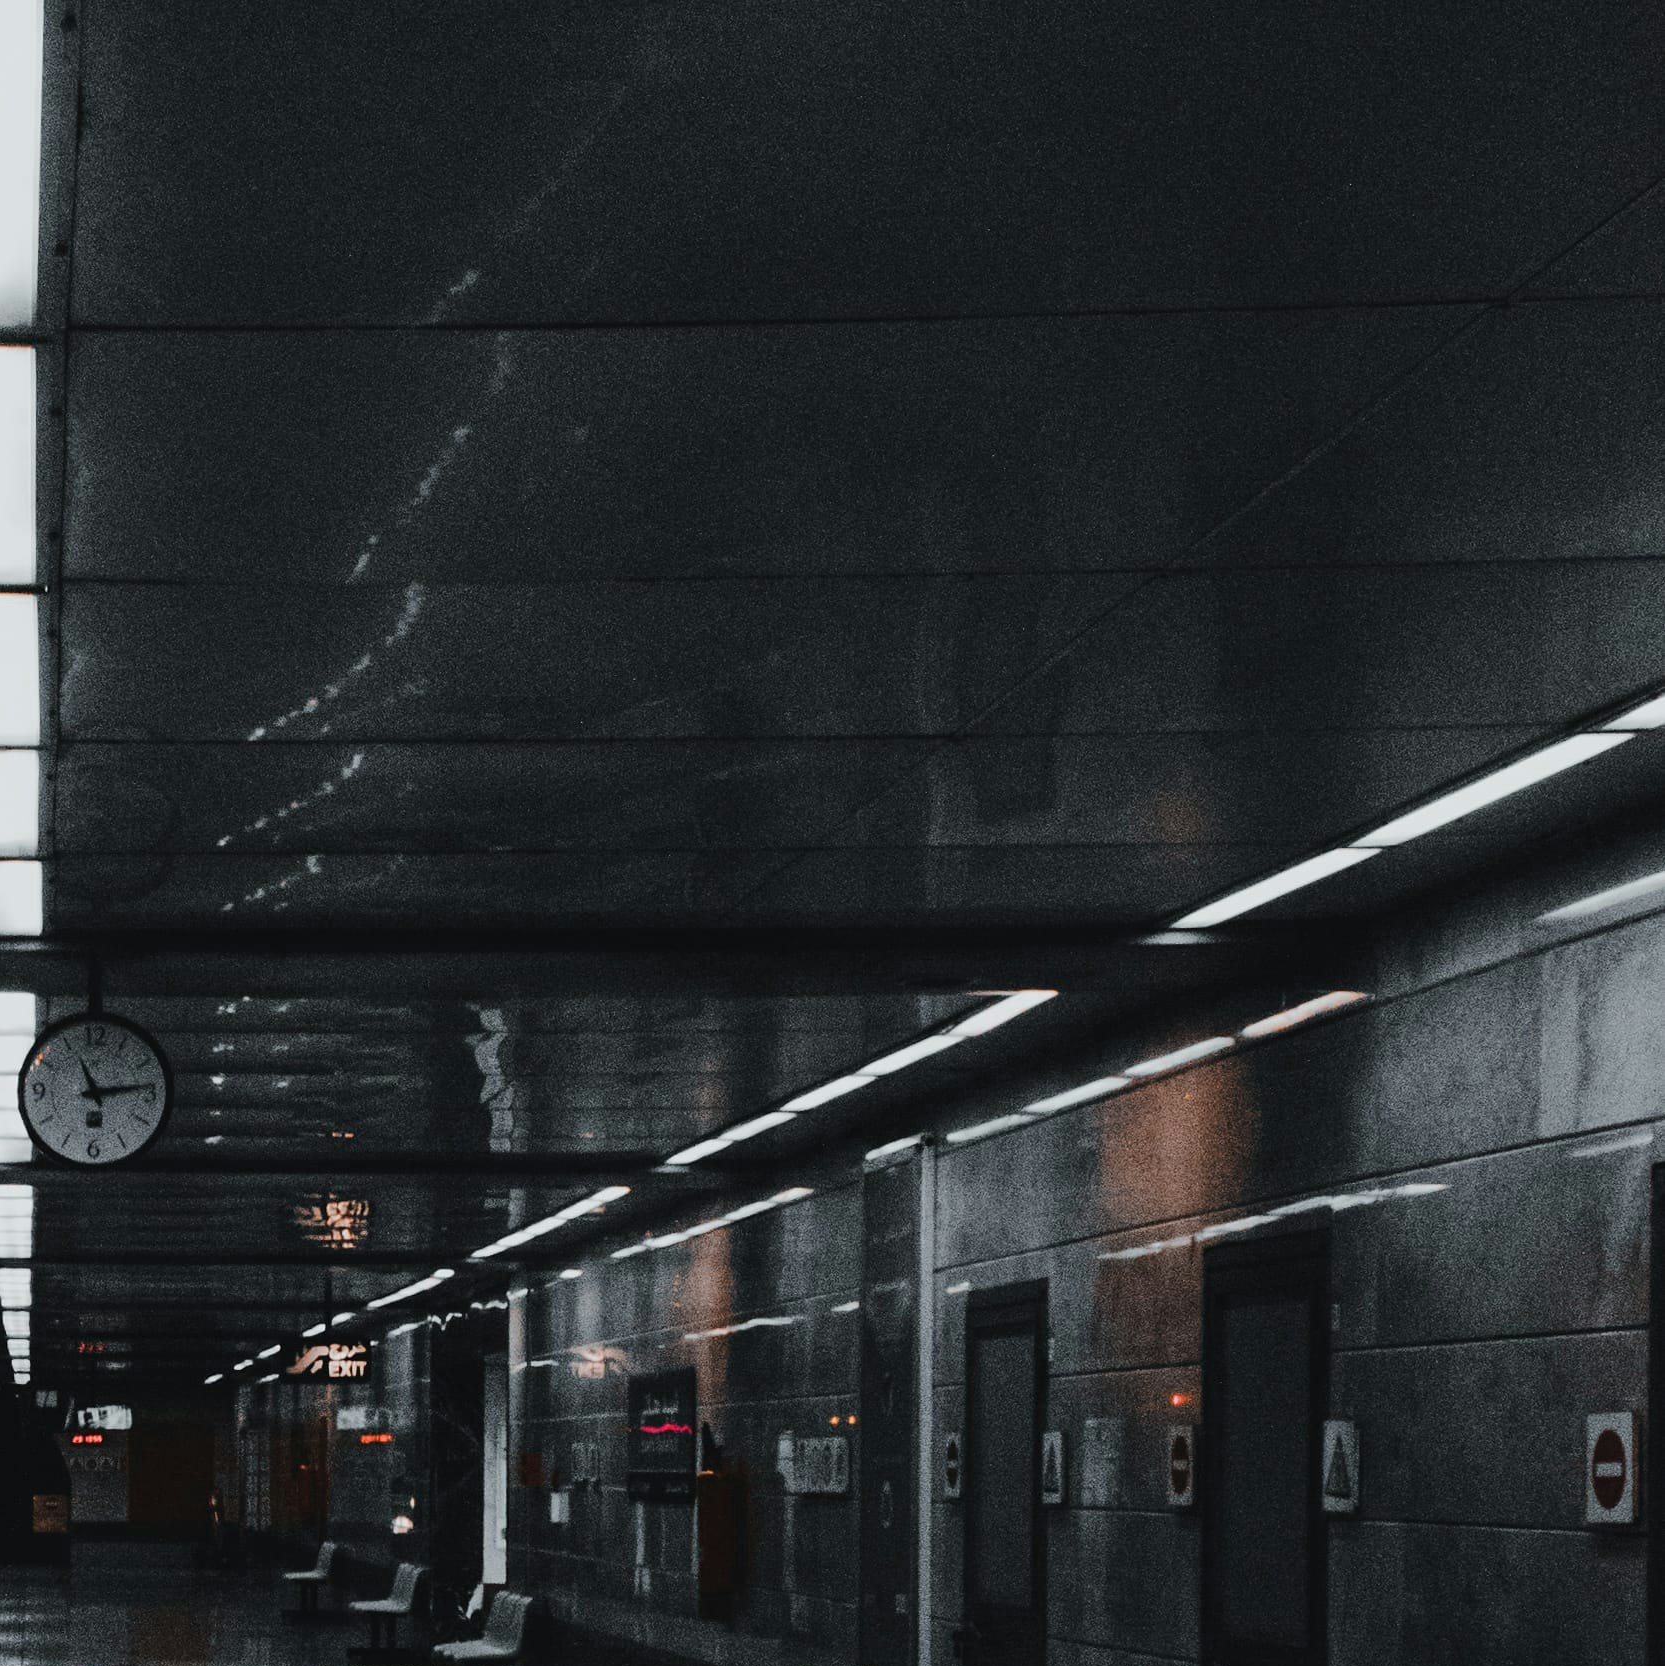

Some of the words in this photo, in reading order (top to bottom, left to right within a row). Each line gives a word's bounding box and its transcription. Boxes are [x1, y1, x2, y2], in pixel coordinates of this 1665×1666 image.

[86, 1026, 106, 1047] 12
[33, 1082, 46, 1102] 9
[87, 1139, 100, 1159] 6
[328, 1360, 368, 1378] EXIT
